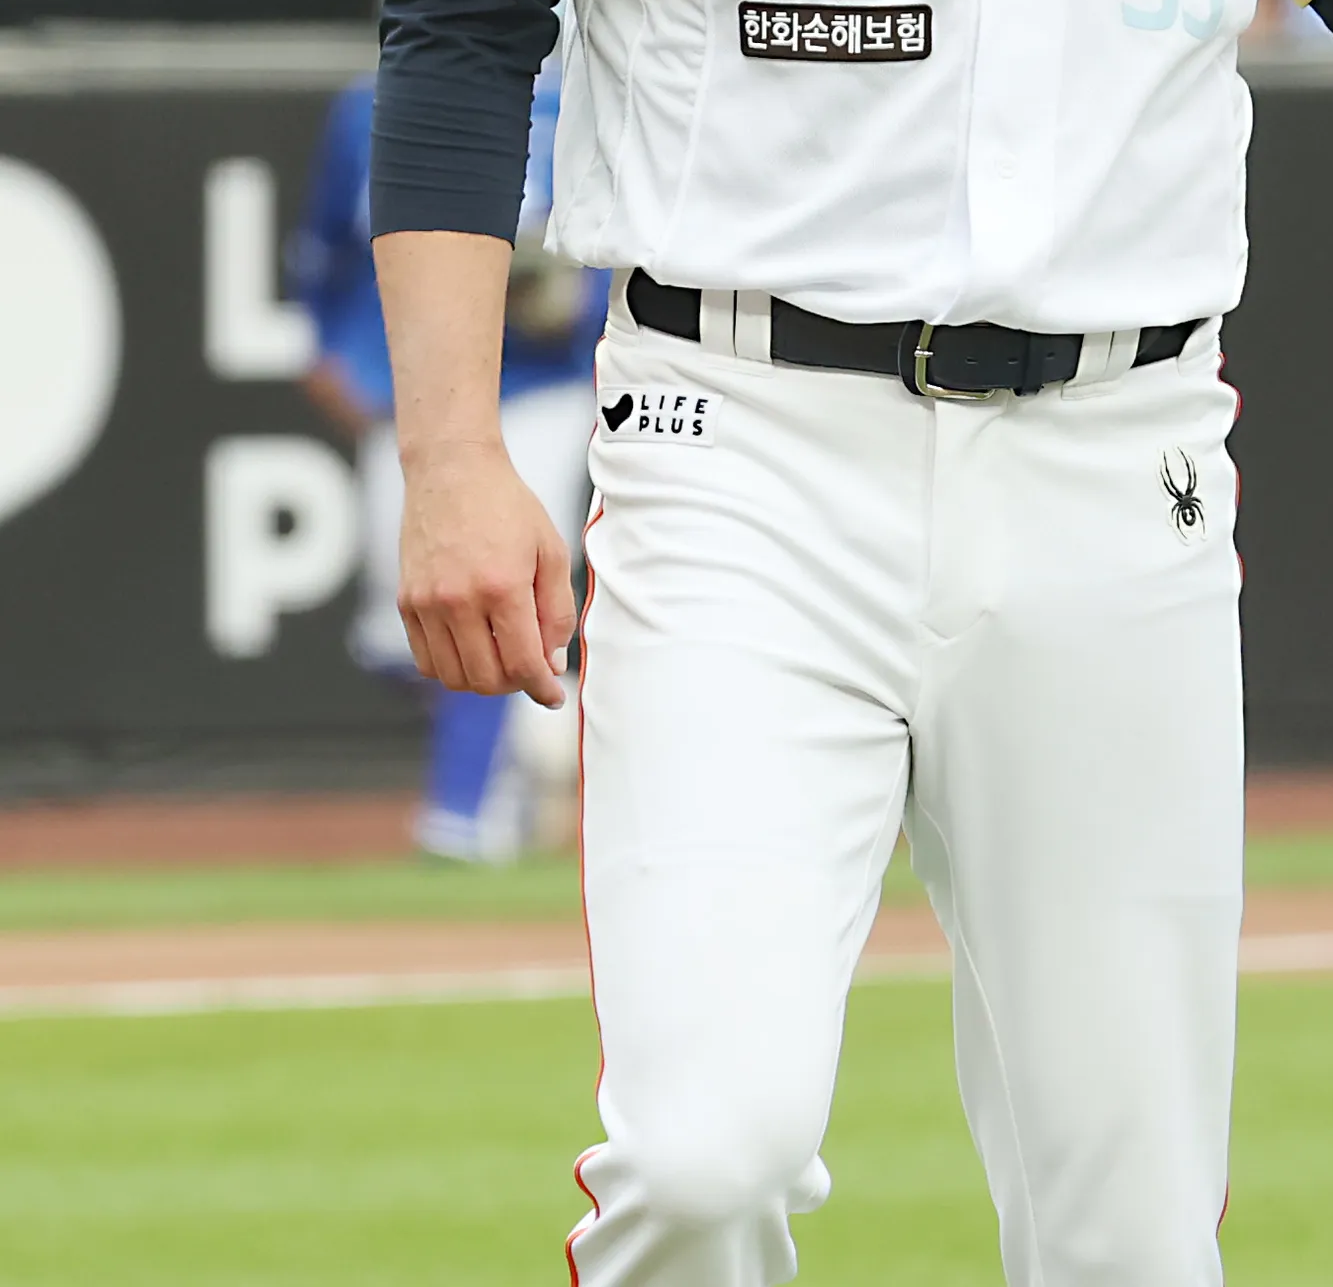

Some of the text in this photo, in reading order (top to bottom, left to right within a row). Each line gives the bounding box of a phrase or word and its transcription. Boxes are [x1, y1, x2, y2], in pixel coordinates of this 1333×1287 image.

[742, 9, 926, 54] 한화손해보험
[640, 394, 709, 415] LIFE
[638, 415, 704, 436] PLUS
